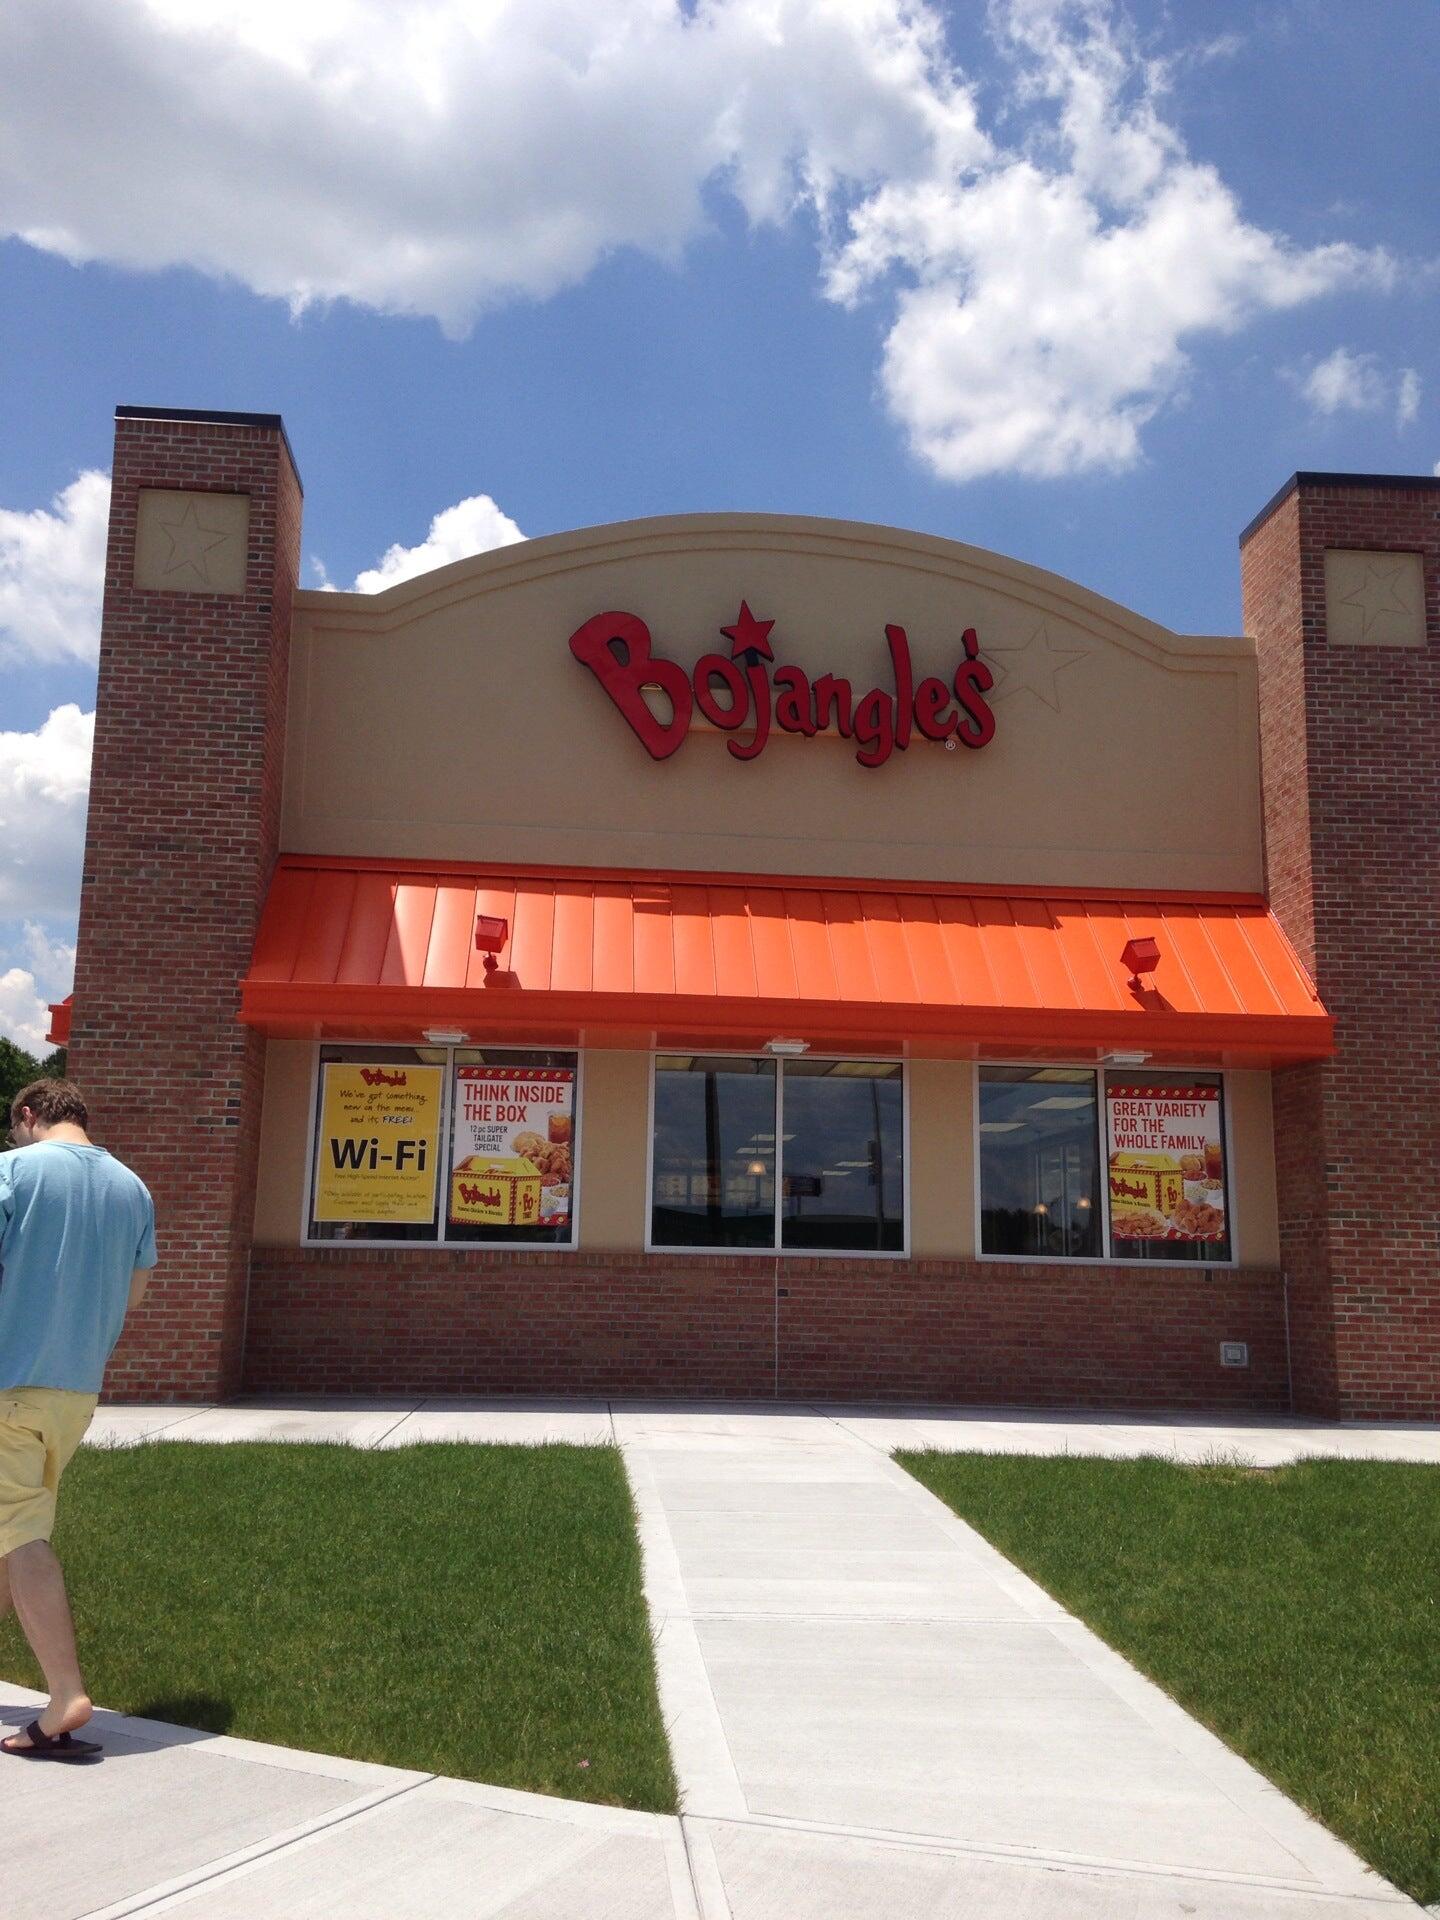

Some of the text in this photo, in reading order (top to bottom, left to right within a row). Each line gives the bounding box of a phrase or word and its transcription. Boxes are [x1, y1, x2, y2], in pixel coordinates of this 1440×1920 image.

[339, 1089, 428, 1106] We've got something
[464, 1083, 564, 1103] THINK INSIDE
[376, 1103, 391, 1111] the
[463, 1104, 527, 1122] THE BOX
[1113, 1101, 1206, 1118] GREAT VARIETY
[382, 1115, 413, 1124] FREE!
[1114, 1118, 1165, 1133] FOR THE
[470, 1125, 477, 1133] 12
[487, 1125, 508, 1134] SUPER
[474, 1134, 503, 1143] TAILGATE
[1114, 1134, 1205, 1150] WHOLE FAMILY
[330, 1137, 427, 1171] Wi-Fi
[474, 1143, 501, 1152] SPECIAL
